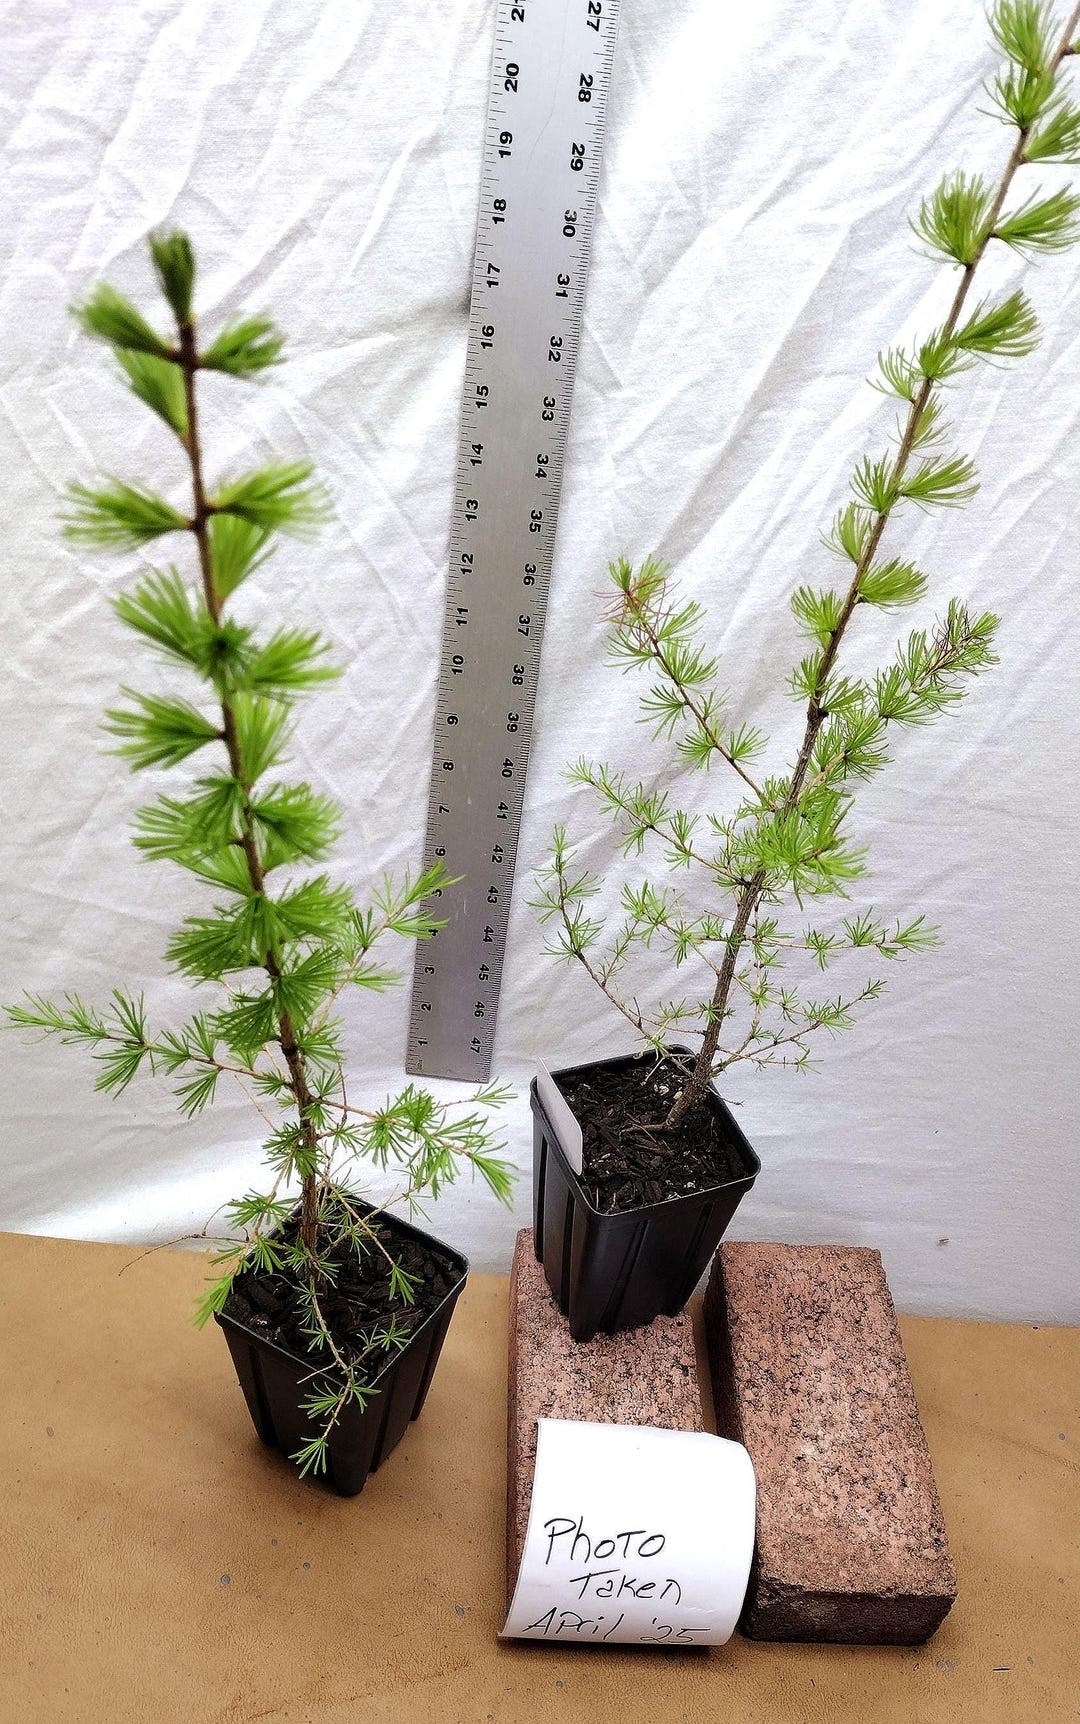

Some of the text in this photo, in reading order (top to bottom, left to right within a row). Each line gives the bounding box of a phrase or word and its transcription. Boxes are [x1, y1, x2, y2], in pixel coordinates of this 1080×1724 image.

[511, 0, 525, 23] 2
[587, 1, 602, 31] 27
[505, 63, 519, 93] 20
[578, 73, 593, 102] 28
[499, 131, 513, 158] 19
[570, 143, 585, 171] 29
[492, 199, 506, 224] 18
[563, 210, 577, 237] 30
[486, 262, 500, 288] 17
[556, 274, 570, 298] 31
[481, 325, 495, 349] 16
[548, 336, 562, 362] 32
[476, 385, 488, 408] 15
[542, 396, 555, 421] 33
[470, 444, 483, 466] 14
[535, 454, 549, 478] 34
[465, 499, 478, 521] 13
[529, 510, 542, 533] 35
[461, 553, 473, 575] 12
[523, 563, 536, 585] 36
[456, 607, 469, 626] 11
[518, 615, 531, 636] 37
[452, 655, 464, 674] 10
[512, 665, 525, 686] 38
[447, 716, 458, 725] 9
[507, 713, 519, 733] 39
[443, 762, 454, 771] 8
[502, 758, 513, 777] 40
[439, 805, 450, 814] 7
[496, 802, 508, 819] 41
[435, 848, 446, 856] 6
[492, 845, 504, 863] 42
[487, 886, 499, 904] 43
[483, 926, 494, 943] 44
[425, 966, 435, 974] 3
[479, 965, 489, 981] 45
[421, 1003, 431, 1011] 2
[474, 1001, 485, 1018] 46
[470, 1037, 481, 1053] 47
[570, 1569, 681, 1605] Taken
[640, 1618, 711, 1643] '25
